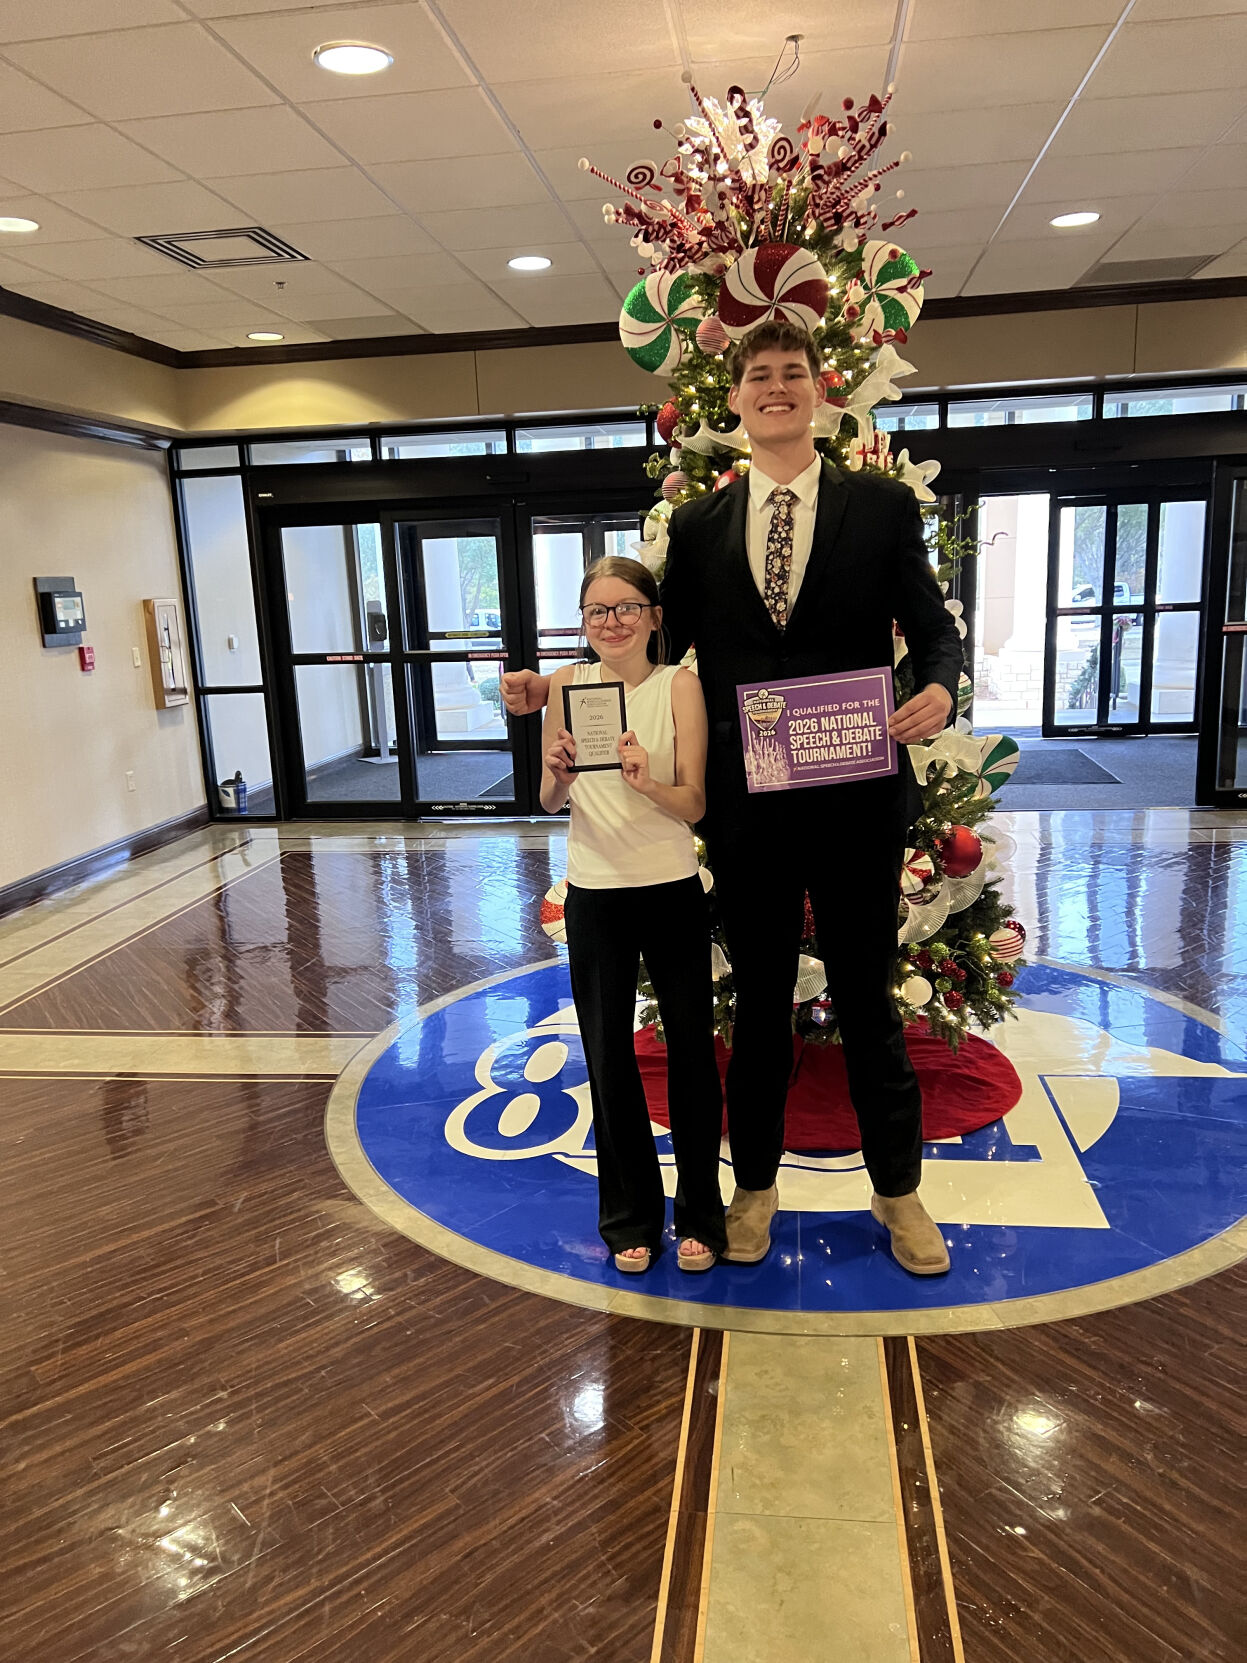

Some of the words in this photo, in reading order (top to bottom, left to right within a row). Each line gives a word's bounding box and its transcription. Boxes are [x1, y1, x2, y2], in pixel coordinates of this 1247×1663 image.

[742, 703, 762, 713] SPEECH
[767, 701, 787, 709] DEBATE
[792, 703, 840, 716] QUALIFIED
[842, 701, 860, 710] FOR
[862, 698, 880, 708] THE
[788, 718, 818, 734] 2026
[821, 711, 877, 731] NATIONAL
[759, 729, 776, 737] 2026
[789, 732, 830, 750] SPEECH
[831, 731, 840, 745] &
[841, 726, 883, 744] DEBATE
[790, 742, 872, 764] TOURNAMENT!
